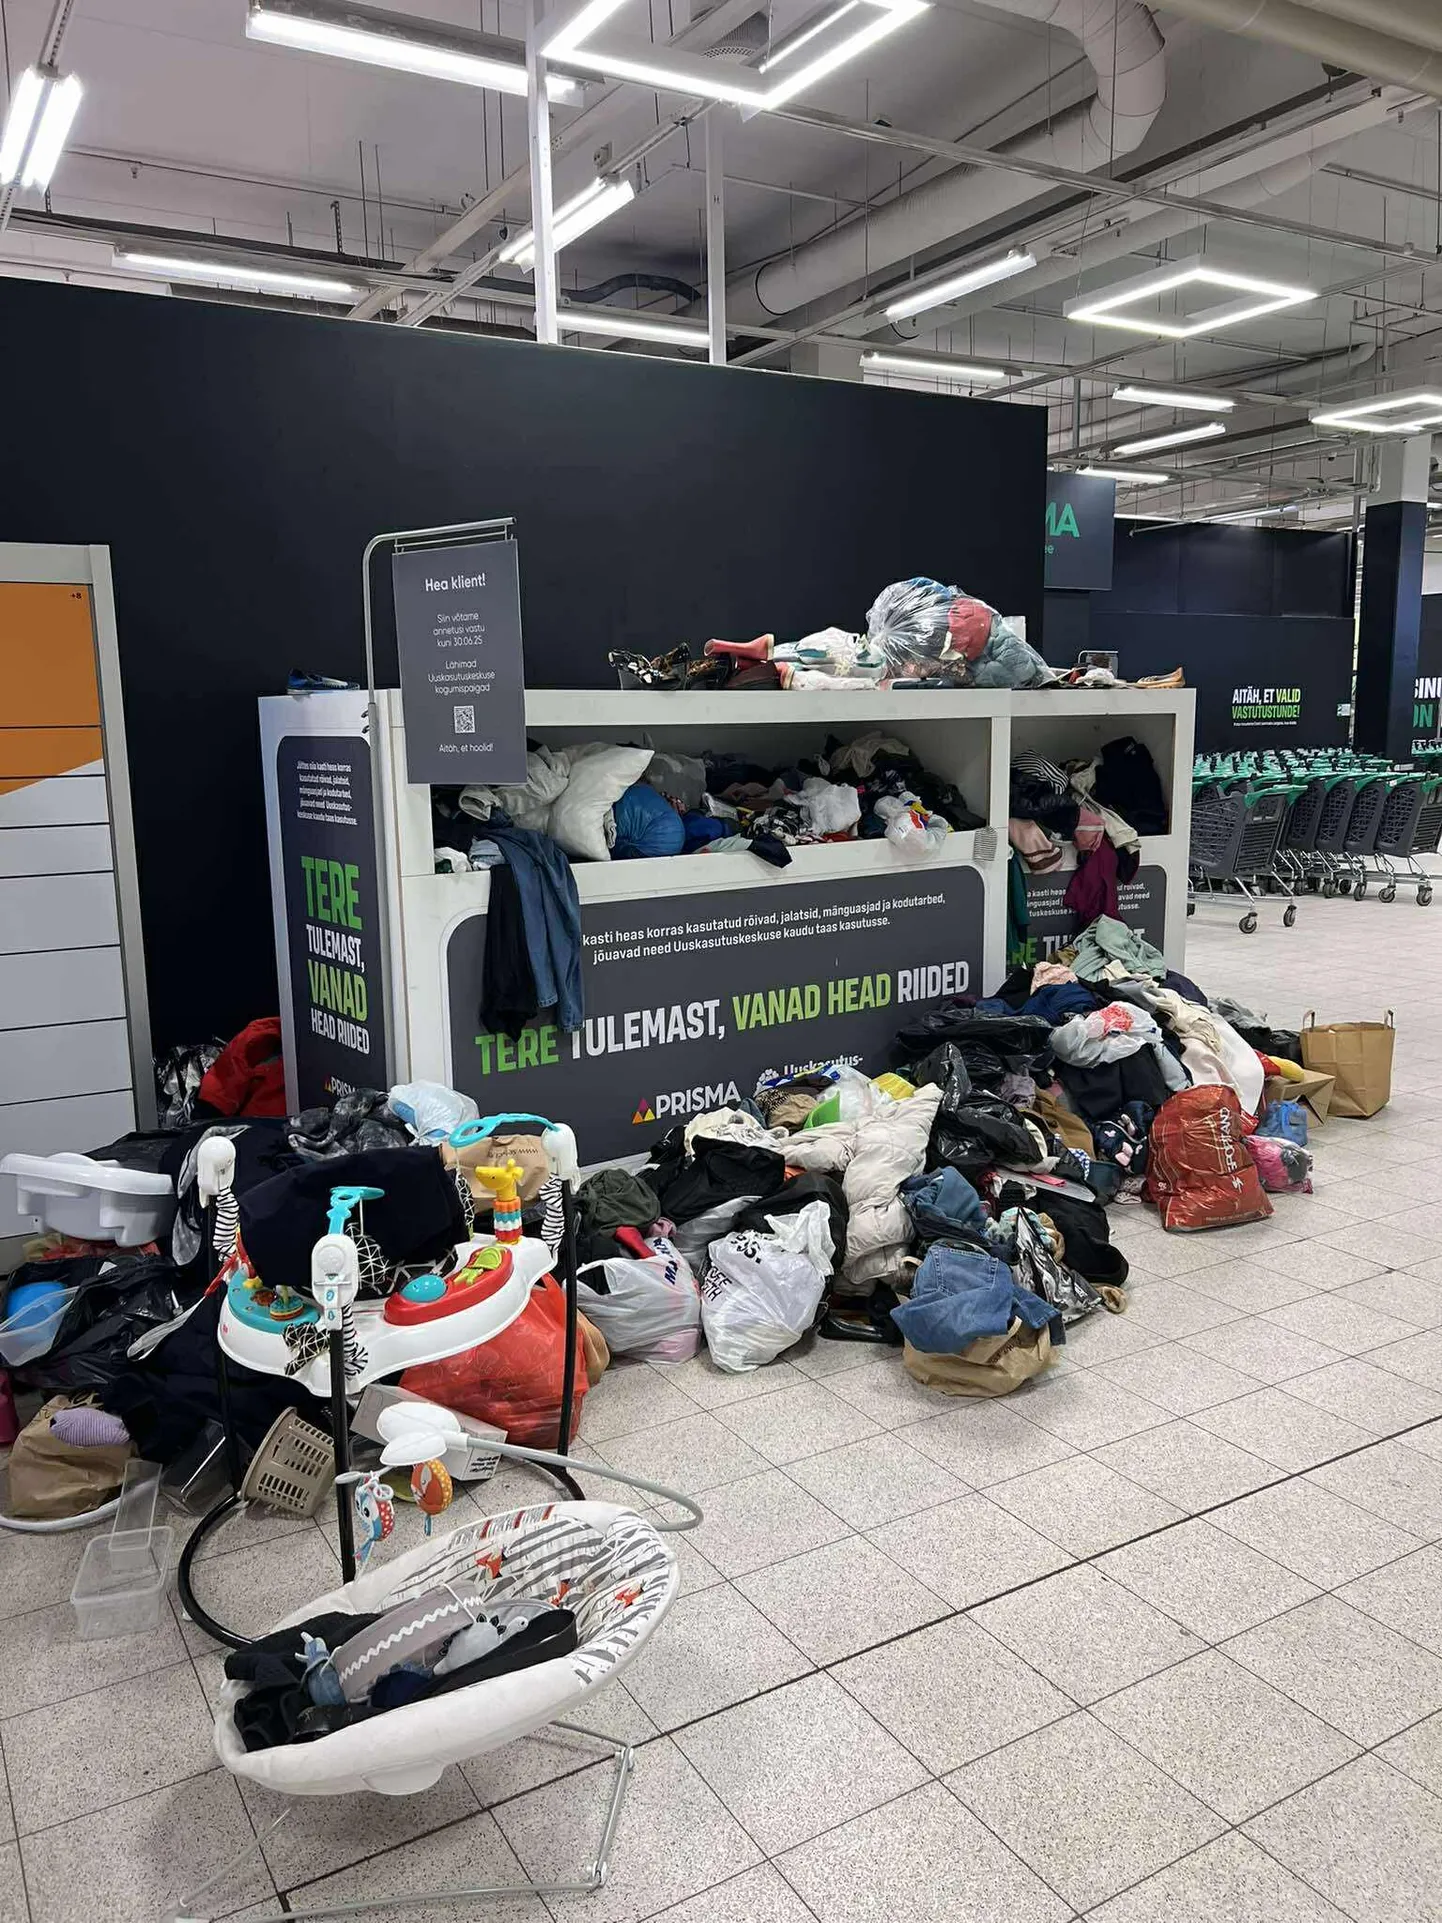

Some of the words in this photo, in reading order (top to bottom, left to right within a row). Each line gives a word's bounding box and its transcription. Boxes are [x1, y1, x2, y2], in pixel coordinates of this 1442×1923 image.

[425, 577, 449, 592] Hea
[451, 572, 486, 590] klient!
[433, 625, 464, 636] annetusi
[465, 624, 486, 634] vastu
[437, 613, 451, 624] Siin
[437, 638, 452, 648] kuni
[453, 634, 483, 647] 30.06.25
[1231, 686, 1262, 705] AITÄH,
[1263, 688, 1275, 704] ET
[1276, 688, 1301, 704] VALID
[1231, 705, 1301, 719] VASTUTUSTUNDE!
[460, 744, 469, 753] et
[469, 742, 494, 752] hoolid!
[300, 855, 363, 931] TERE
[582, 931, 613, 947] kasti
[615, 928, 645, 943] heas
[647, 925, 684, 940] korras
[685, 915, 742, 935] kasutatud
[743, 911, 779, 928] rõivad,
[780, 907, 822, 925] jalatsid,
[823, 900, 881, 918] mänguasjad
[882, 898, 891, 913] ja
[892, 893, 946, 910] kodutarbed,
[305, 924, 365, 973] TULEMAST,
[593, 944, 641, 966] jõuavad
[643, 941, 672, 957] need
[673, 929, 782, 953] Uuskasutuskeskuse
[784, 924, 814, 939] kaudu
[816, 921, 838, 934] taas
[839, 915, 890, 932] kasutusse.
[307, 957, 369, 1024] VANAD
[310, 1006, 337, 1041] HEAD
[337, 1018, 371, 1055] RIIDED
[475, 1025, 560, 1075] TERE
[571, 998, 726, 1060] TULEMAST,
[732, 983, 822, 1031] VANAD
[827, 972, 892, 1016] HEAD
[897, 960, 970, 1004] RIIDED
[655, 1080, 742, 1120] PRISMA
